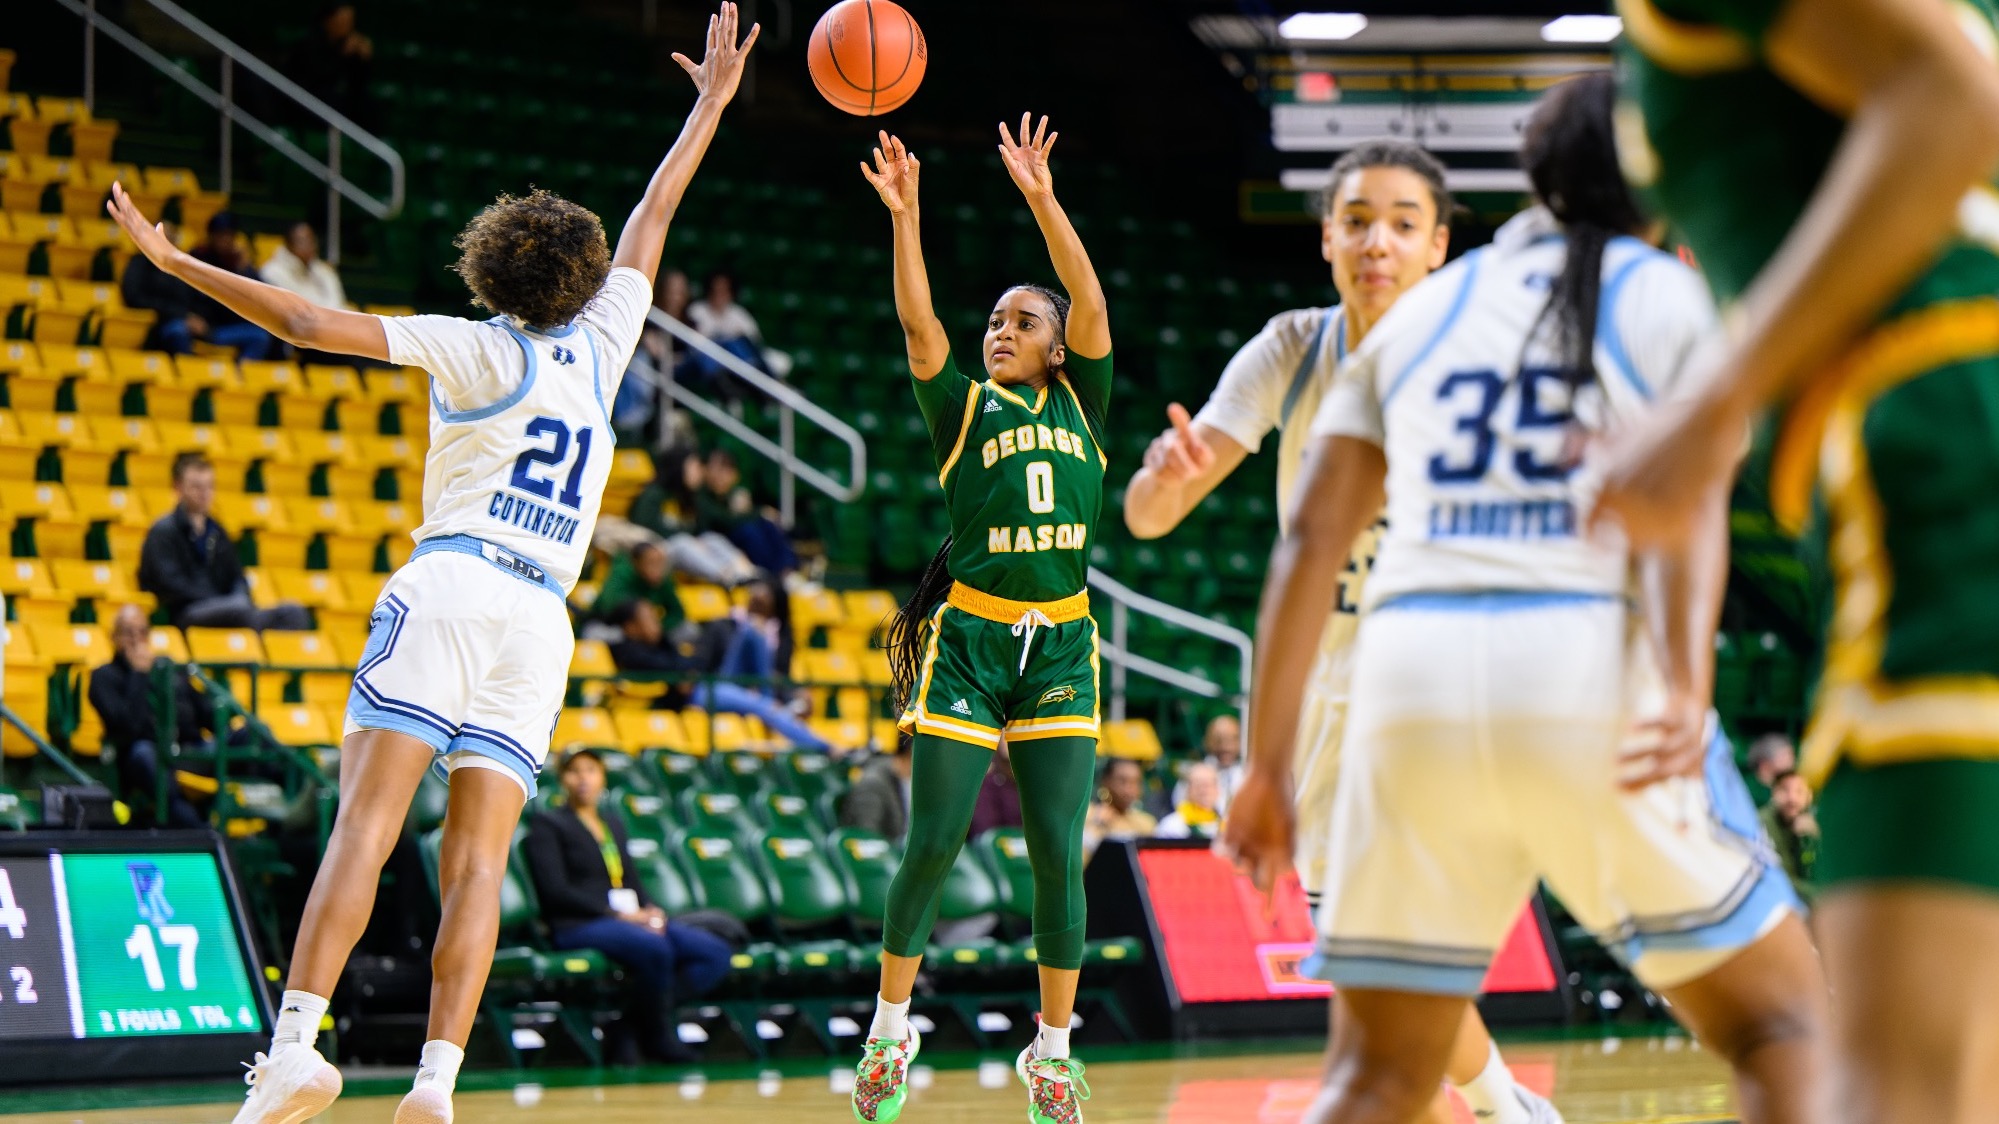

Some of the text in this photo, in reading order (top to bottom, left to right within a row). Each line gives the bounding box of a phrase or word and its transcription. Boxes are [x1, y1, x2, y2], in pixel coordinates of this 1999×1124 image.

[983, 405, 1003, 414] didas
[1428, 367, 1583, 483] 35
[510, 415, 593, 511] 21
[981, 423, 1087, 469] GEORGE
[1025, 461, 1055, 514] 0
[488, 490, 581, 546] COVINGTON
[988, 523, 1087, 554] MASON
[950, 705, 972, 716] adidas
[125, 924, 199, 991] 17
[9, 966, 38, 1004] 2
[117, 1008, 182, 1031] FOULS
